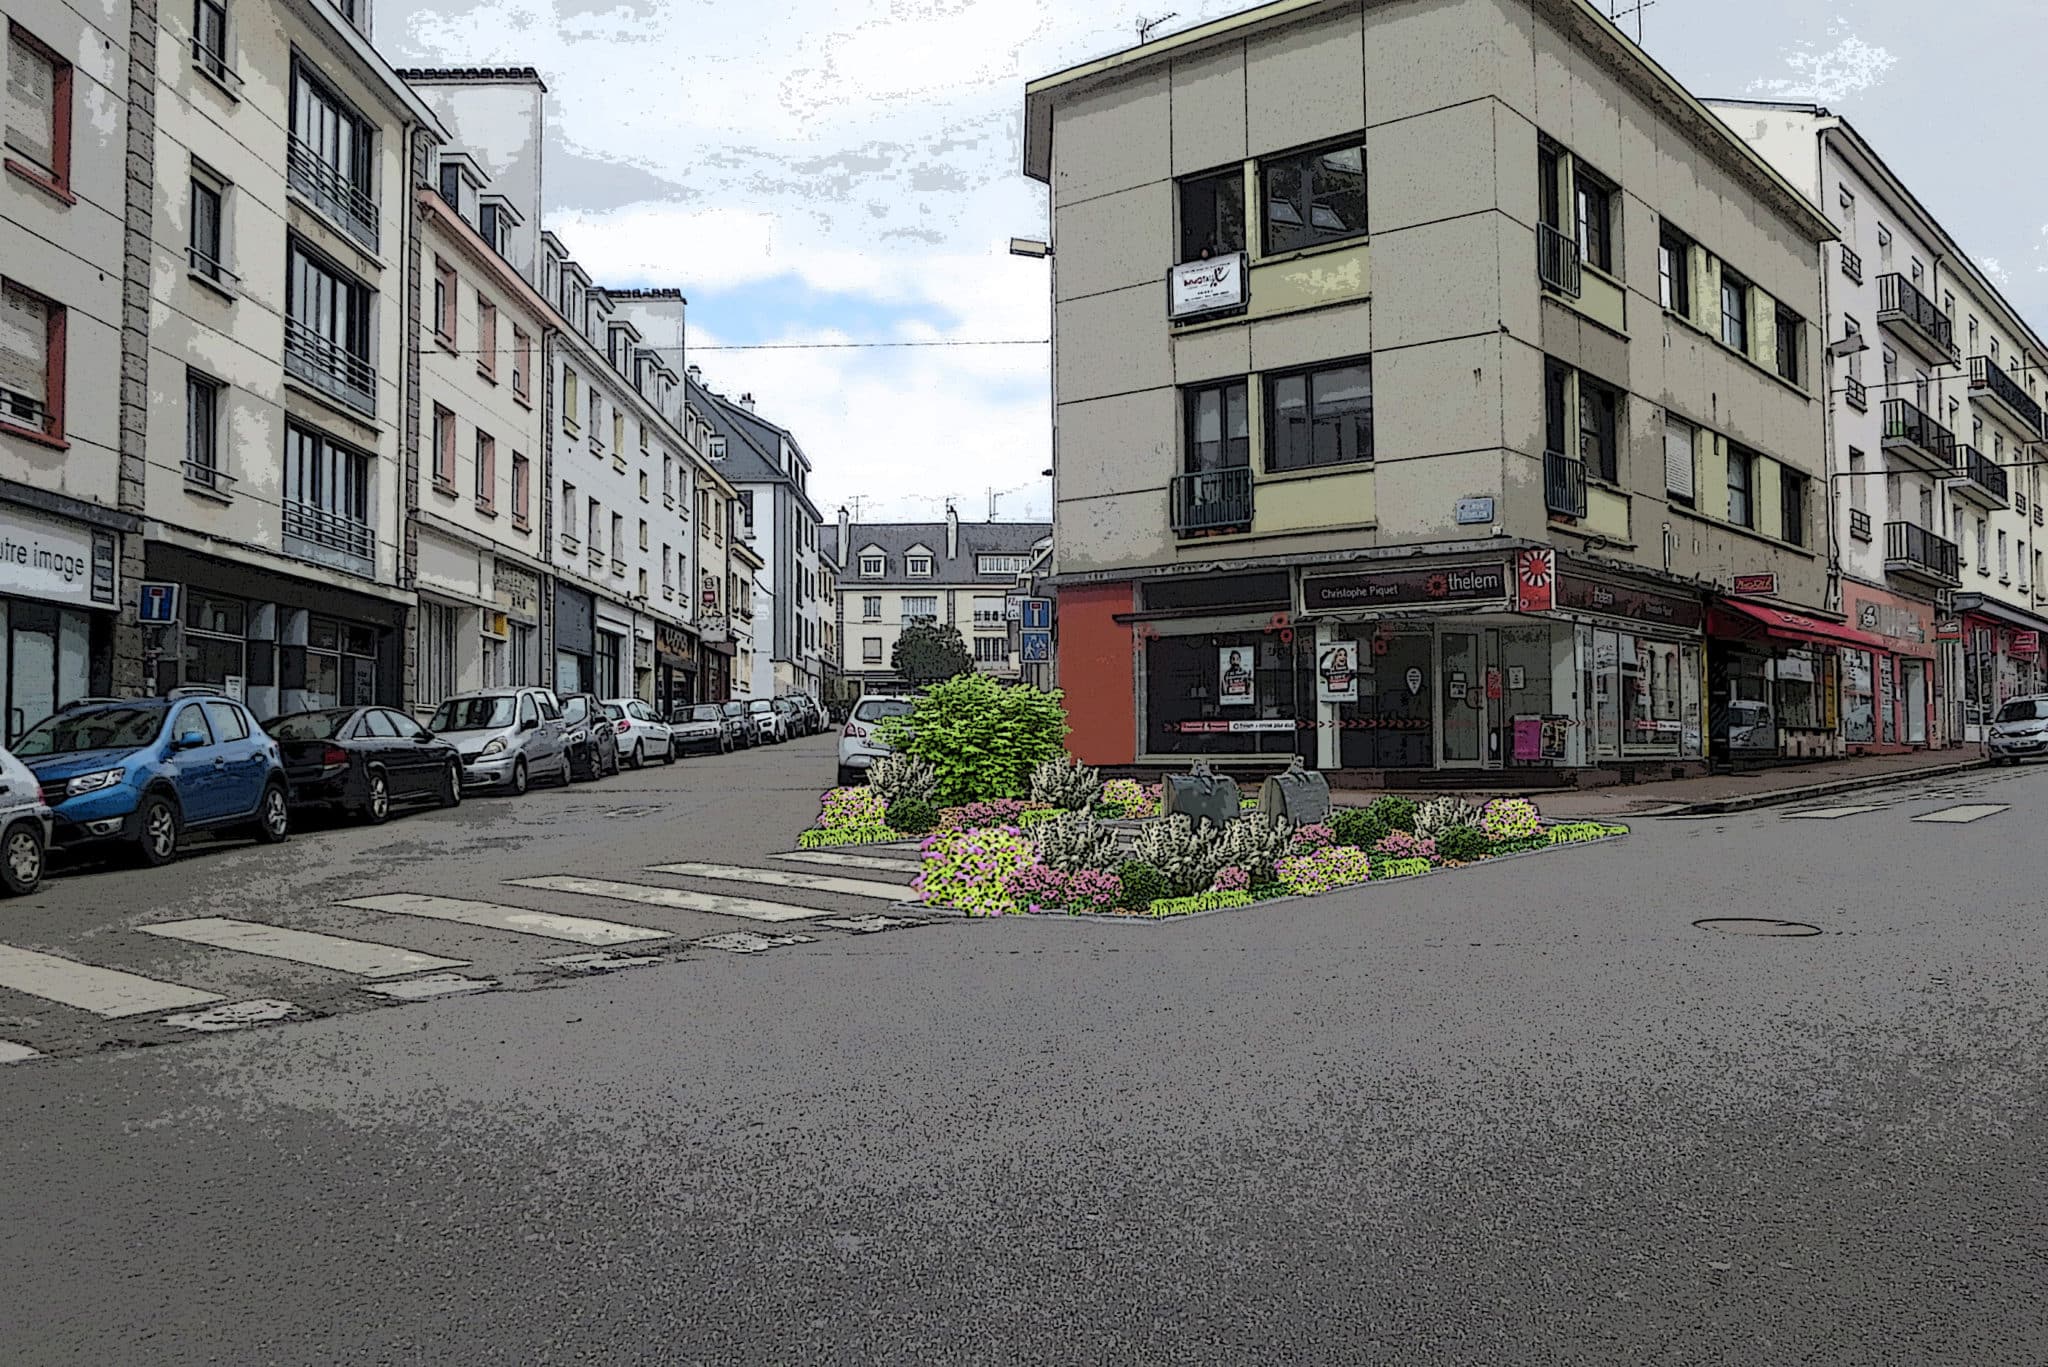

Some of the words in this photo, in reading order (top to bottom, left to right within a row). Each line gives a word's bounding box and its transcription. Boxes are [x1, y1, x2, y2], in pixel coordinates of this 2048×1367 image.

[33, 541, 85, 582] image
[1321, 586, 1367, 600] Christophe
[1369, 585, 1399, 598] Piquet
